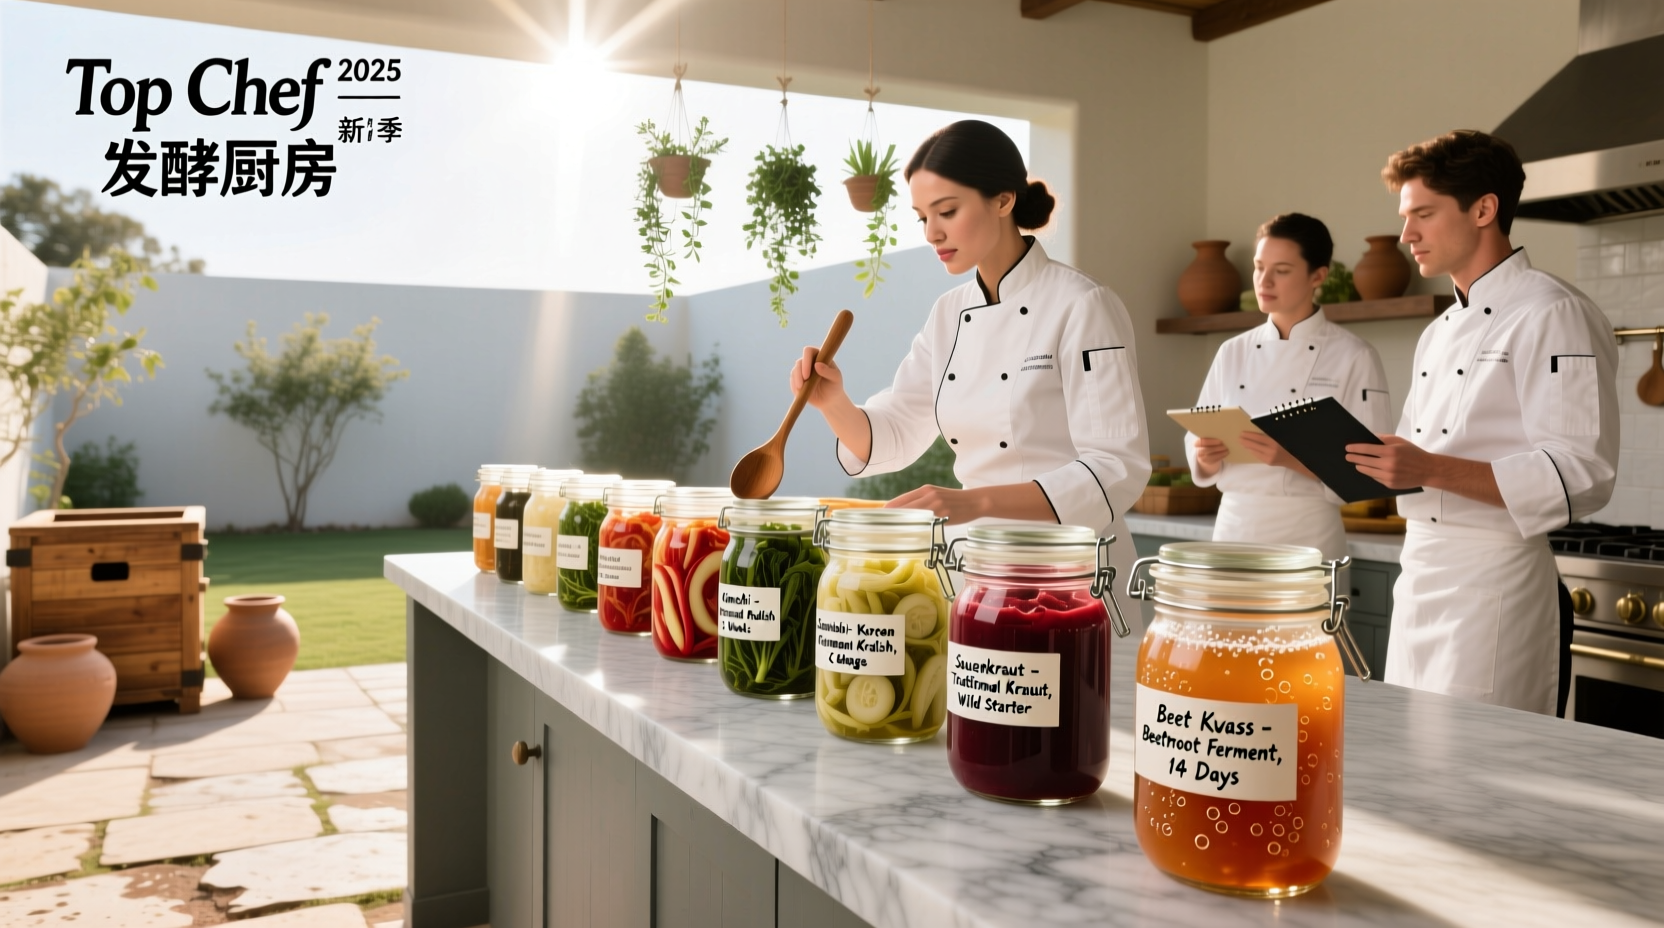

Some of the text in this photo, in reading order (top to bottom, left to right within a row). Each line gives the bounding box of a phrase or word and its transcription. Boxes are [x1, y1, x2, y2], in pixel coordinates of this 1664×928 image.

[957, 691, 1032, 714] Wild Starter
[1156, 703, 1192, 728] Beet
[1200, 710, 1254, 736] Kvass
[1206, 738, 1282, 766] Ferment,
[1168, 757, 1239, 791] 14 Days
